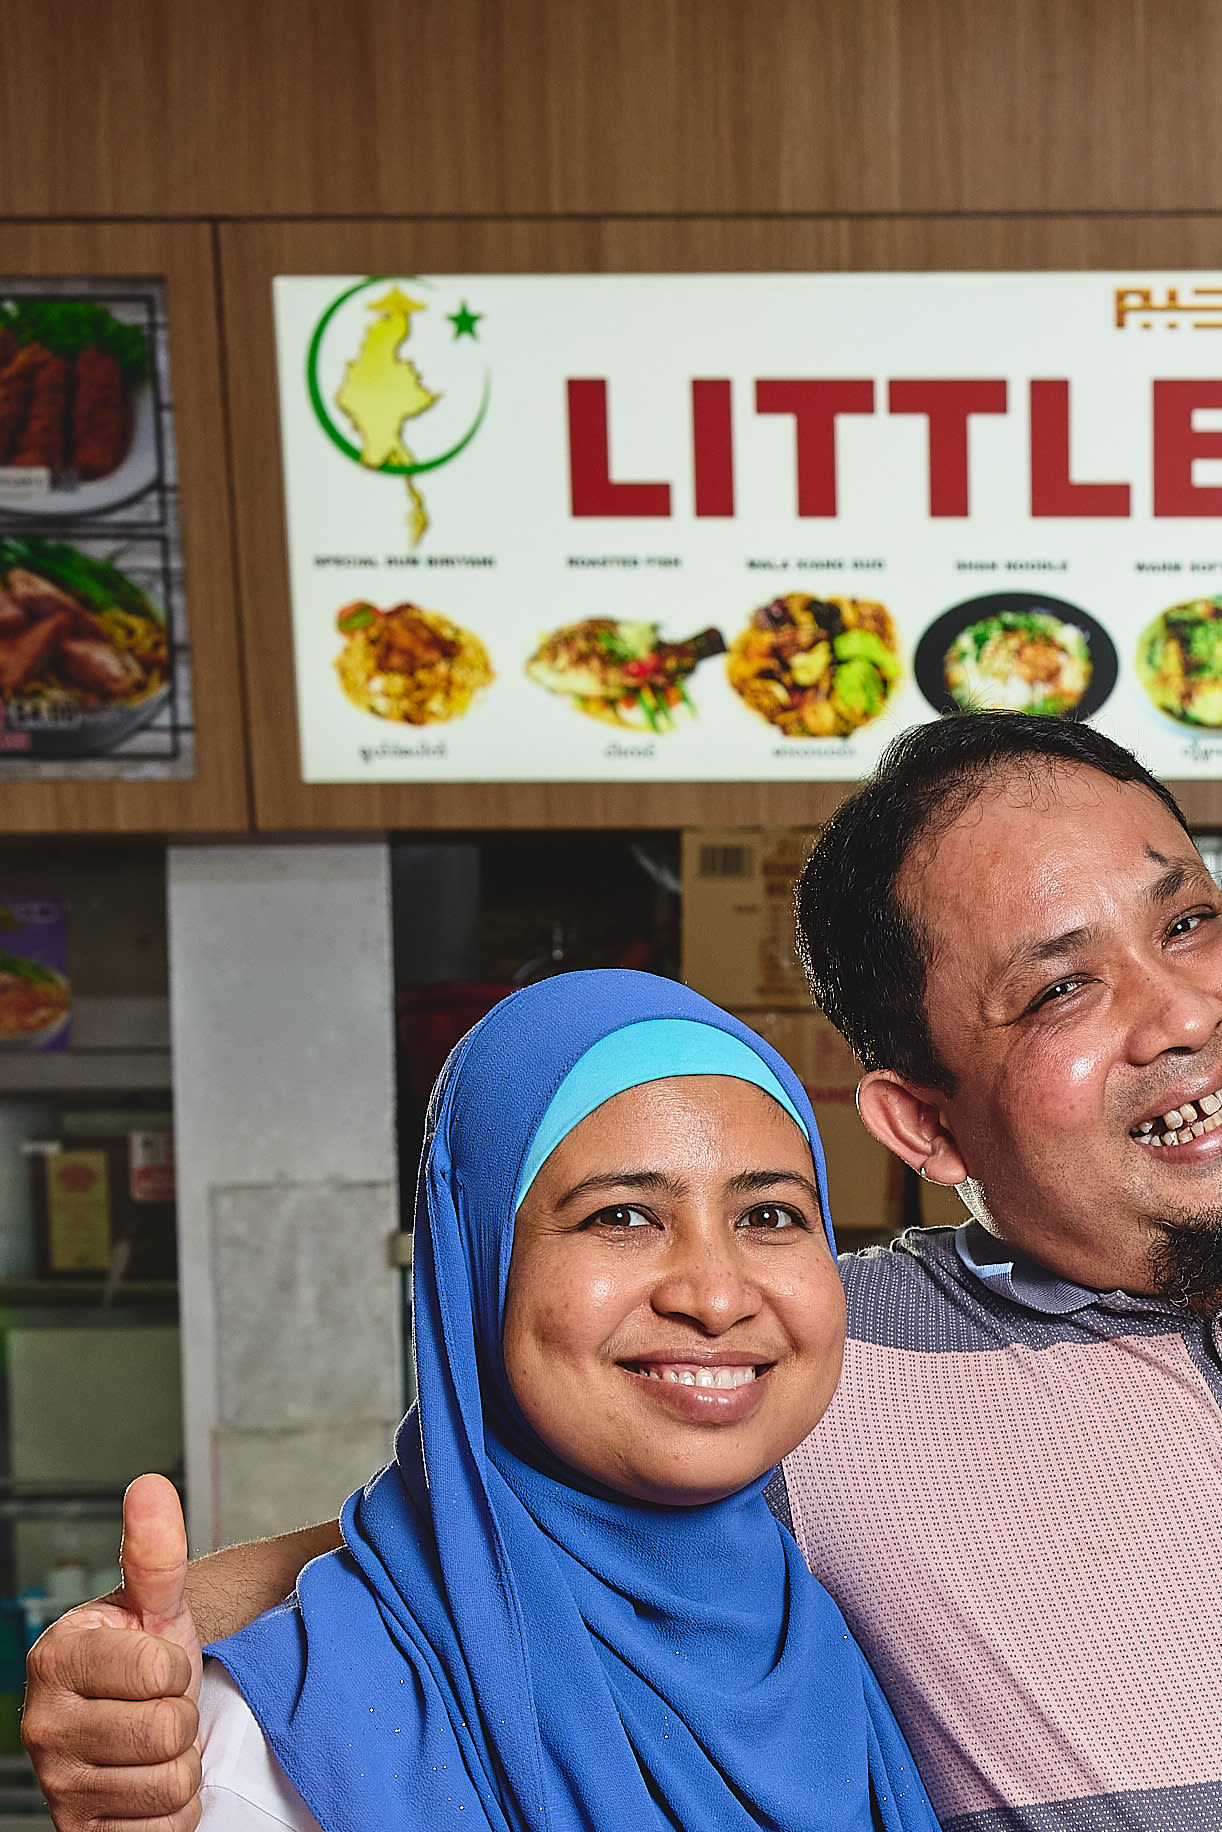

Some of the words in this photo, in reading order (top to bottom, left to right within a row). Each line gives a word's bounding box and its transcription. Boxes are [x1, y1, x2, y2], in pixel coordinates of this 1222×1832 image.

[313, 554, 379, 569] SPECIAL
[565, 555, 640, 569] ROASTED
[1003, 558, 1068, 573] NOODLE
